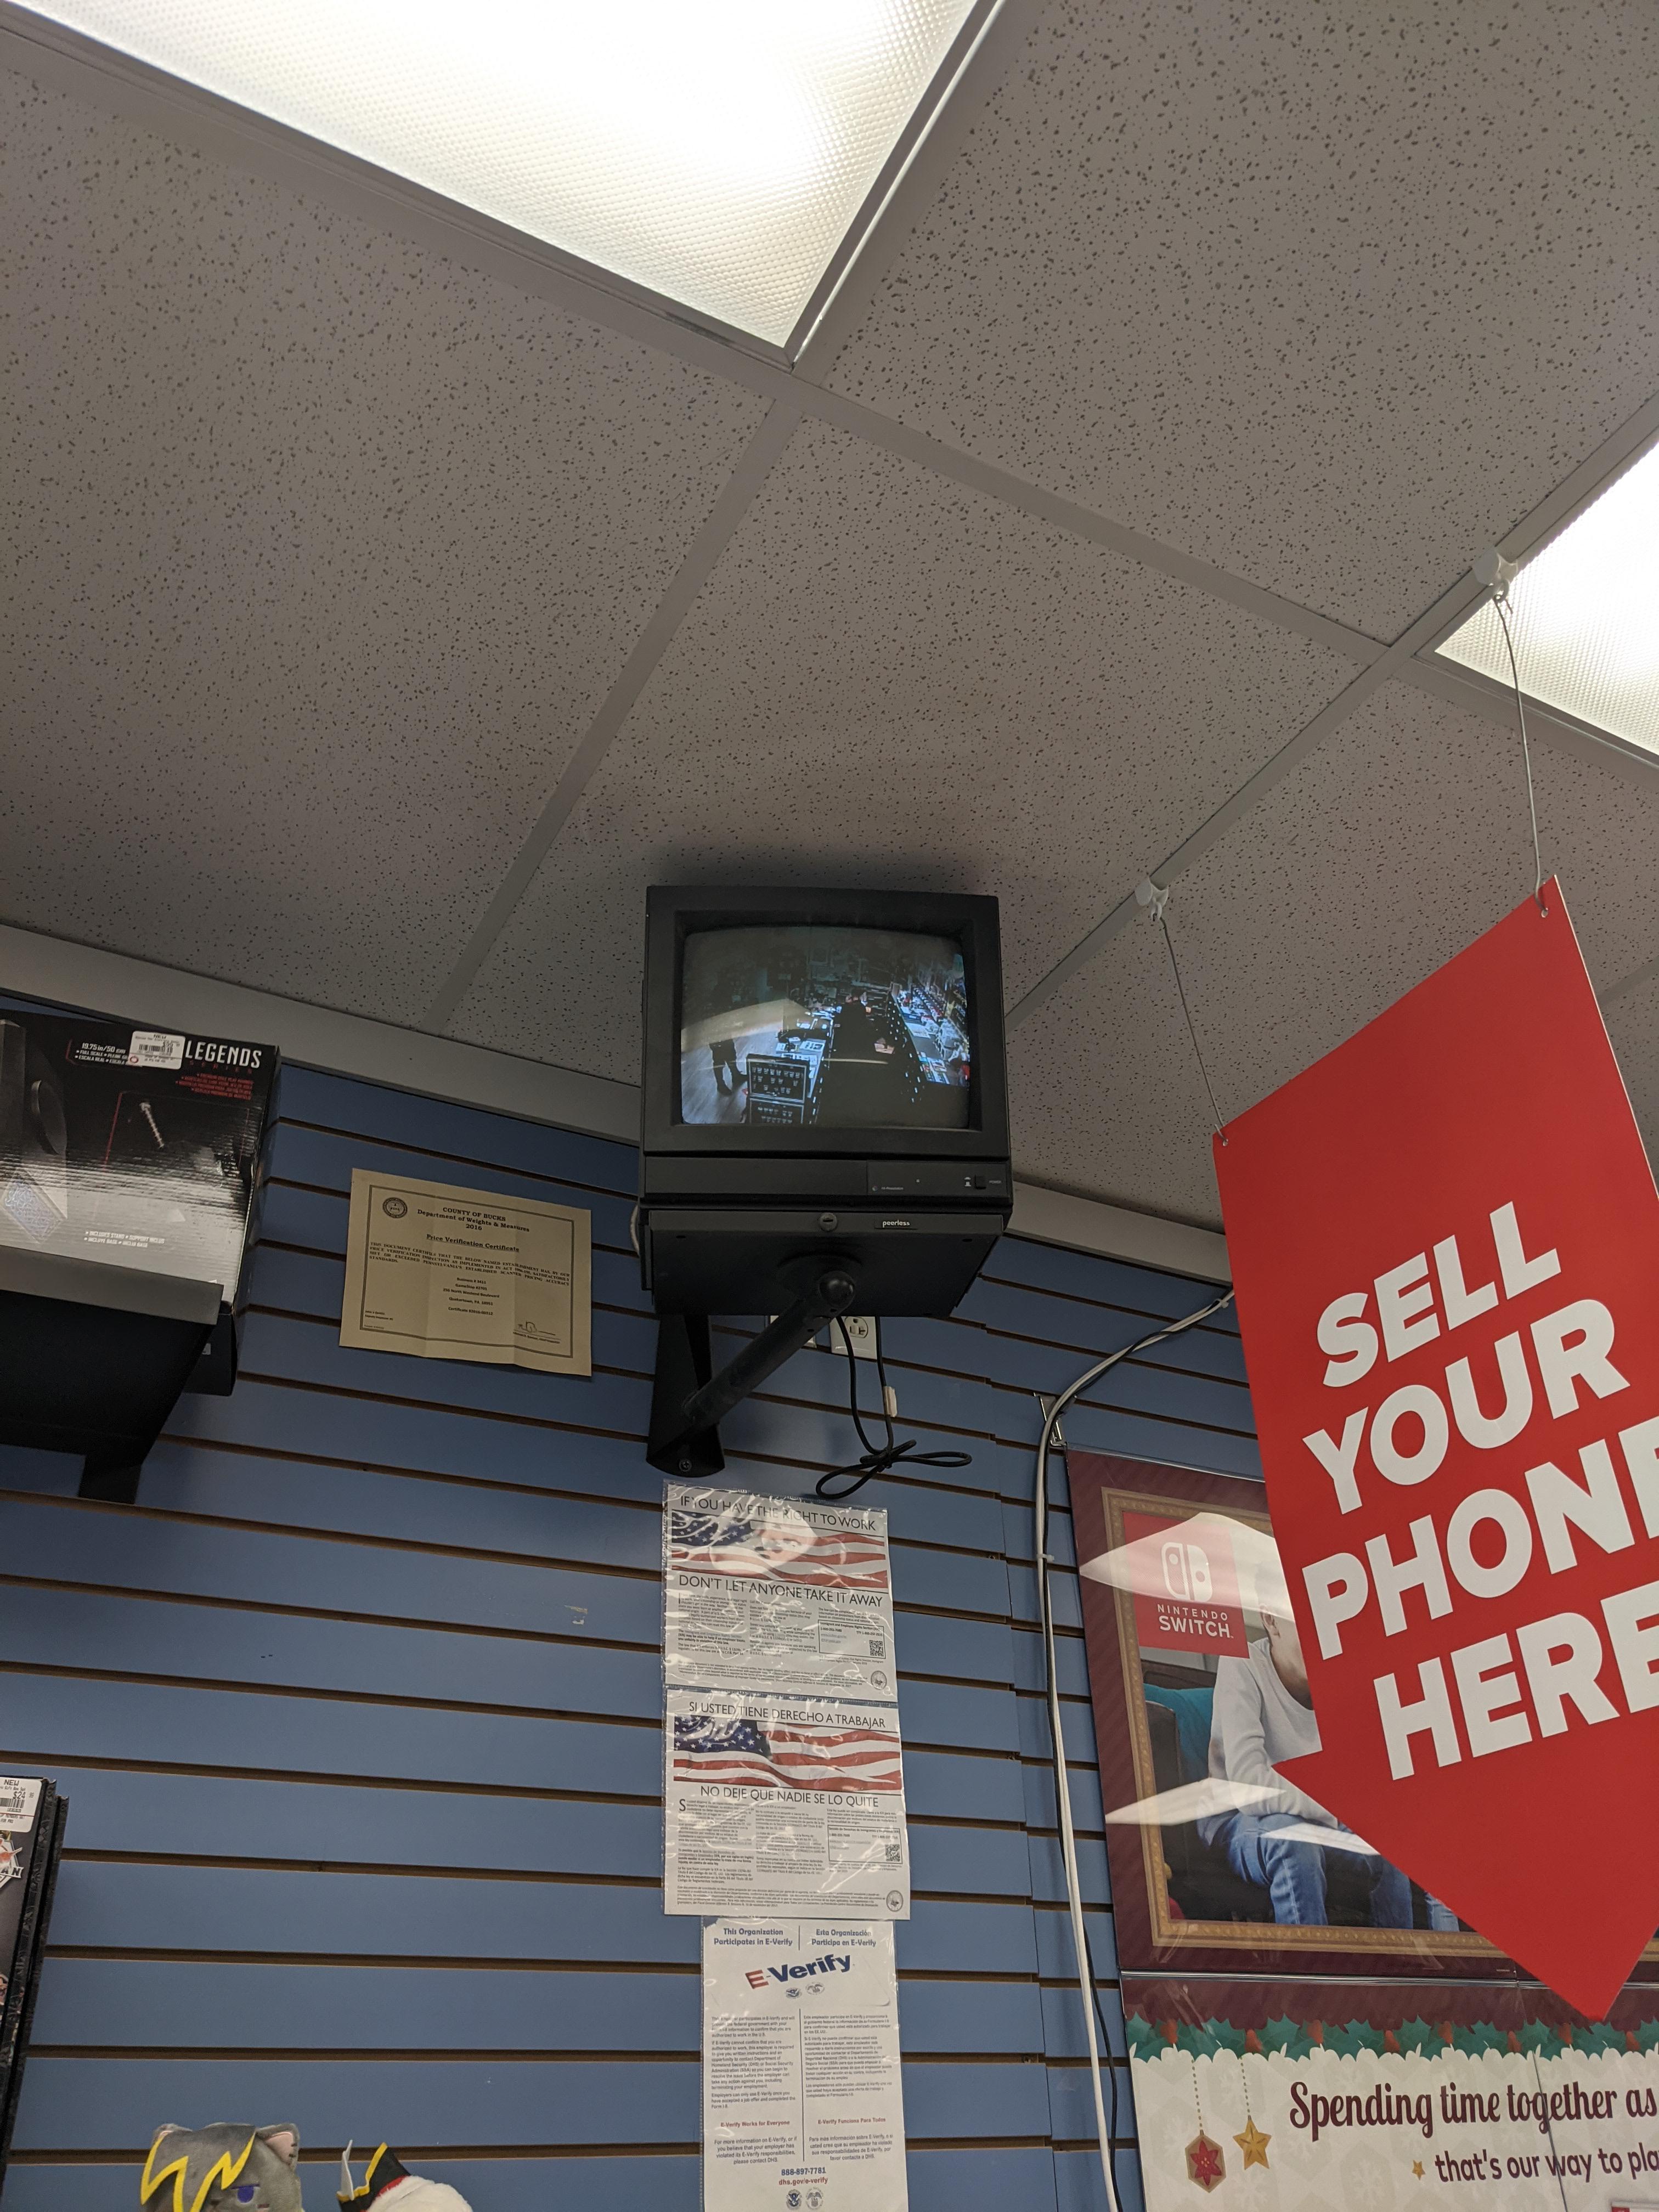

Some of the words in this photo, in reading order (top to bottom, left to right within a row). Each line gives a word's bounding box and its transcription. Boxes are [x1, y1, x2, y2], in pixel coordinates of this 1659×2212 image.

[185, 1041, 262, 1068] LEGENDS
[417, 1209, 456, 1220] Department
[466, 1217, 492, 1226] Weights
[500, 1222, 529, 1232] Measures
[443, 1207, 471, 1216] COUNTY
[484, 1214, 506, 1222] BUCKS
[882, 1220, 910, 1228] peerless
[445, 1237, 483, 1248] Verification
[485, 1243, 520, 1252] Certificate
[387, 1249, 420, 1257] VERIFICATION
[459, 1261, 494, 1269] IMPLEMENTED
[503, 1262, 538, 1272] ESTABLISHMENT
[1317, 1200, 1561, 1388] SELL
[1302, 1299, 1631, 1515] YOUR
[681, 1496, 689, 1506] IF
[723, 1502, 754, 1515] HAVE
[757, 1505, 778, 1517] THE
[782, 1508, 817, 1523] RIGHT
[820, 1514, 837, 1525] TO
[838, 1516, 876, 1531] WORK
[679, 1574, 722, 1590] DON'T
[726, 1579, 743, 1592] LET
[748, 1582, 804, 1598] ANYONE
[803, 1588, 833, 1603] TAKE
[836, 1592, 847, 1603] IT
[849, 1593, 883, 1607] AWAY
[1157, 1603, 1228, 1621] NINTENDO
[1158, 1615, 1231, 1639] SWITCH
[1373, 1580, 1659, 1781] HERE
[689, 1702, 698, 1712] SI
[701, 1703, 737, 1714] USTED
[740, 1706, 769, 1718] TIENE
[771, 1709, 823, 1722] DERECHO
[826, 1713, 833, 1723] A
[835, 1714, 885, 1729] TRABAJAR
[13, 1791, 26, 1799] $24
[701, 1786, 720, 1797] NO
[724, 1787, 747, 1801] DEJE
[750, 1790, 774, 1802] QUE
[777, 1791, 811, 1803] NADIE
[814, 1793, 825, 1804] SE
[828, 1795, 843, 1805] LO
[845, 1796, 878, 1809] QUITE
[765, 1939, 793, 1947] E-Verify
[831, 1929, 871, 1937] Organización
[745, 1954, 850, 1990] E-Verify
[1289, 2081, 1433, 2143] Spending
[1441, 2082, 1501, 2124] time
[1507, 2081, 1617, 2134] together
[1626, 2087, 1658, 2118] as
[781, 2166, 827, 2176] 888-897-7781
[1435, 2149, 1502, 2183] that's
[1507, 2154, 1540, 2179] our
[1545, 2153, 1592, 2183] way
[1598, 2148, 1623, 2174] to
[1628, 2142, 1659, 2180] pla
[778, 2176, 828, 2186] dhs.gov/e-verify
